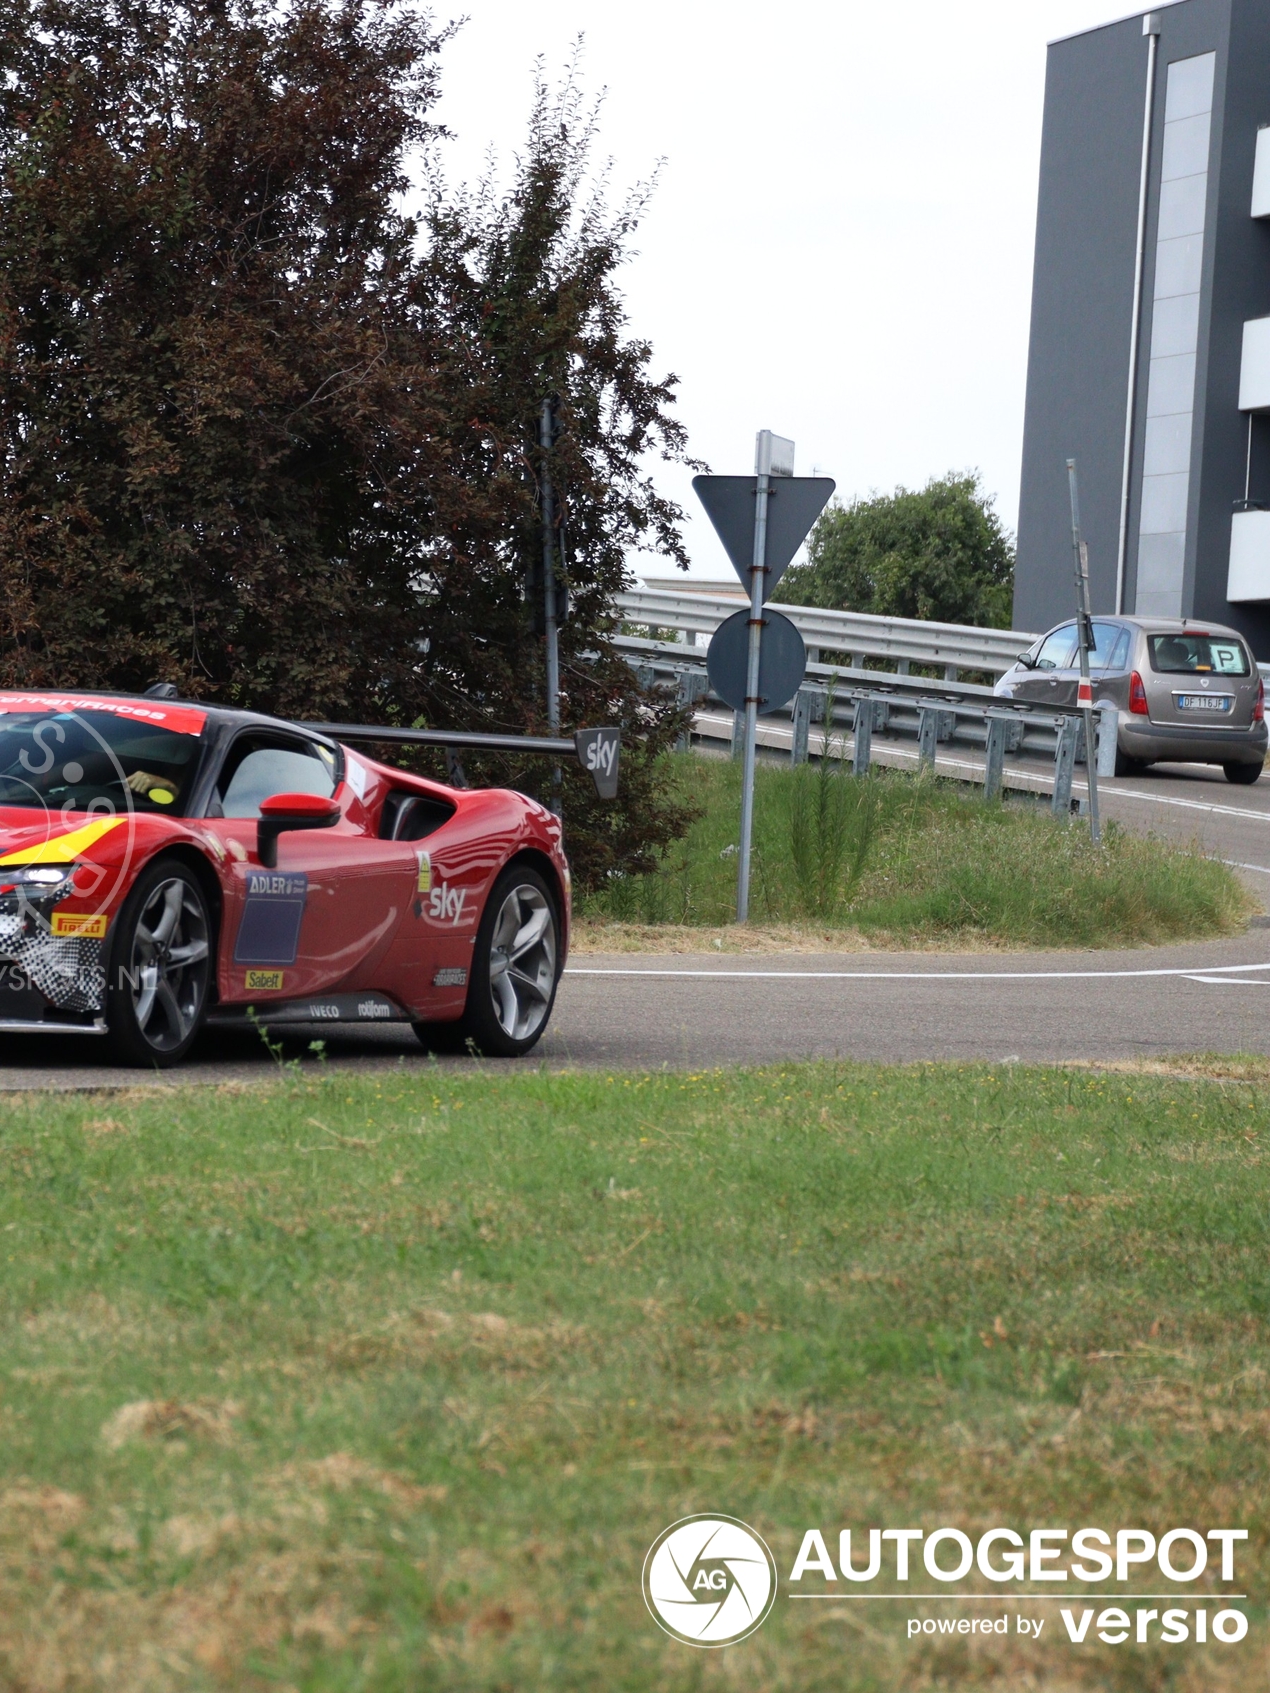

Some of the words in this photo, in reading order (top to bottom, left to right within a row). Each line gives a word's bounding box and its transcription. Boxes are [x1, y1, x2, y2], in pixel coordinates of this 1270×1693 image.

[1217, 650, 1234, 668] P
[1184, 697, 1195, 707] DF
[1198, 697, 1223, 708] 116JF
[587, 732, 617, 777] sky
[249, 876, 285, 894] ADLER
[430, 881, 466, 926] sky
[57, 917, 101, 933] PIRELLI
[249, 971, 279, 988] Sabelt
[309, 1005, 340, 1018] IVECO
[357, 1000, 390, 1018] rotiform
